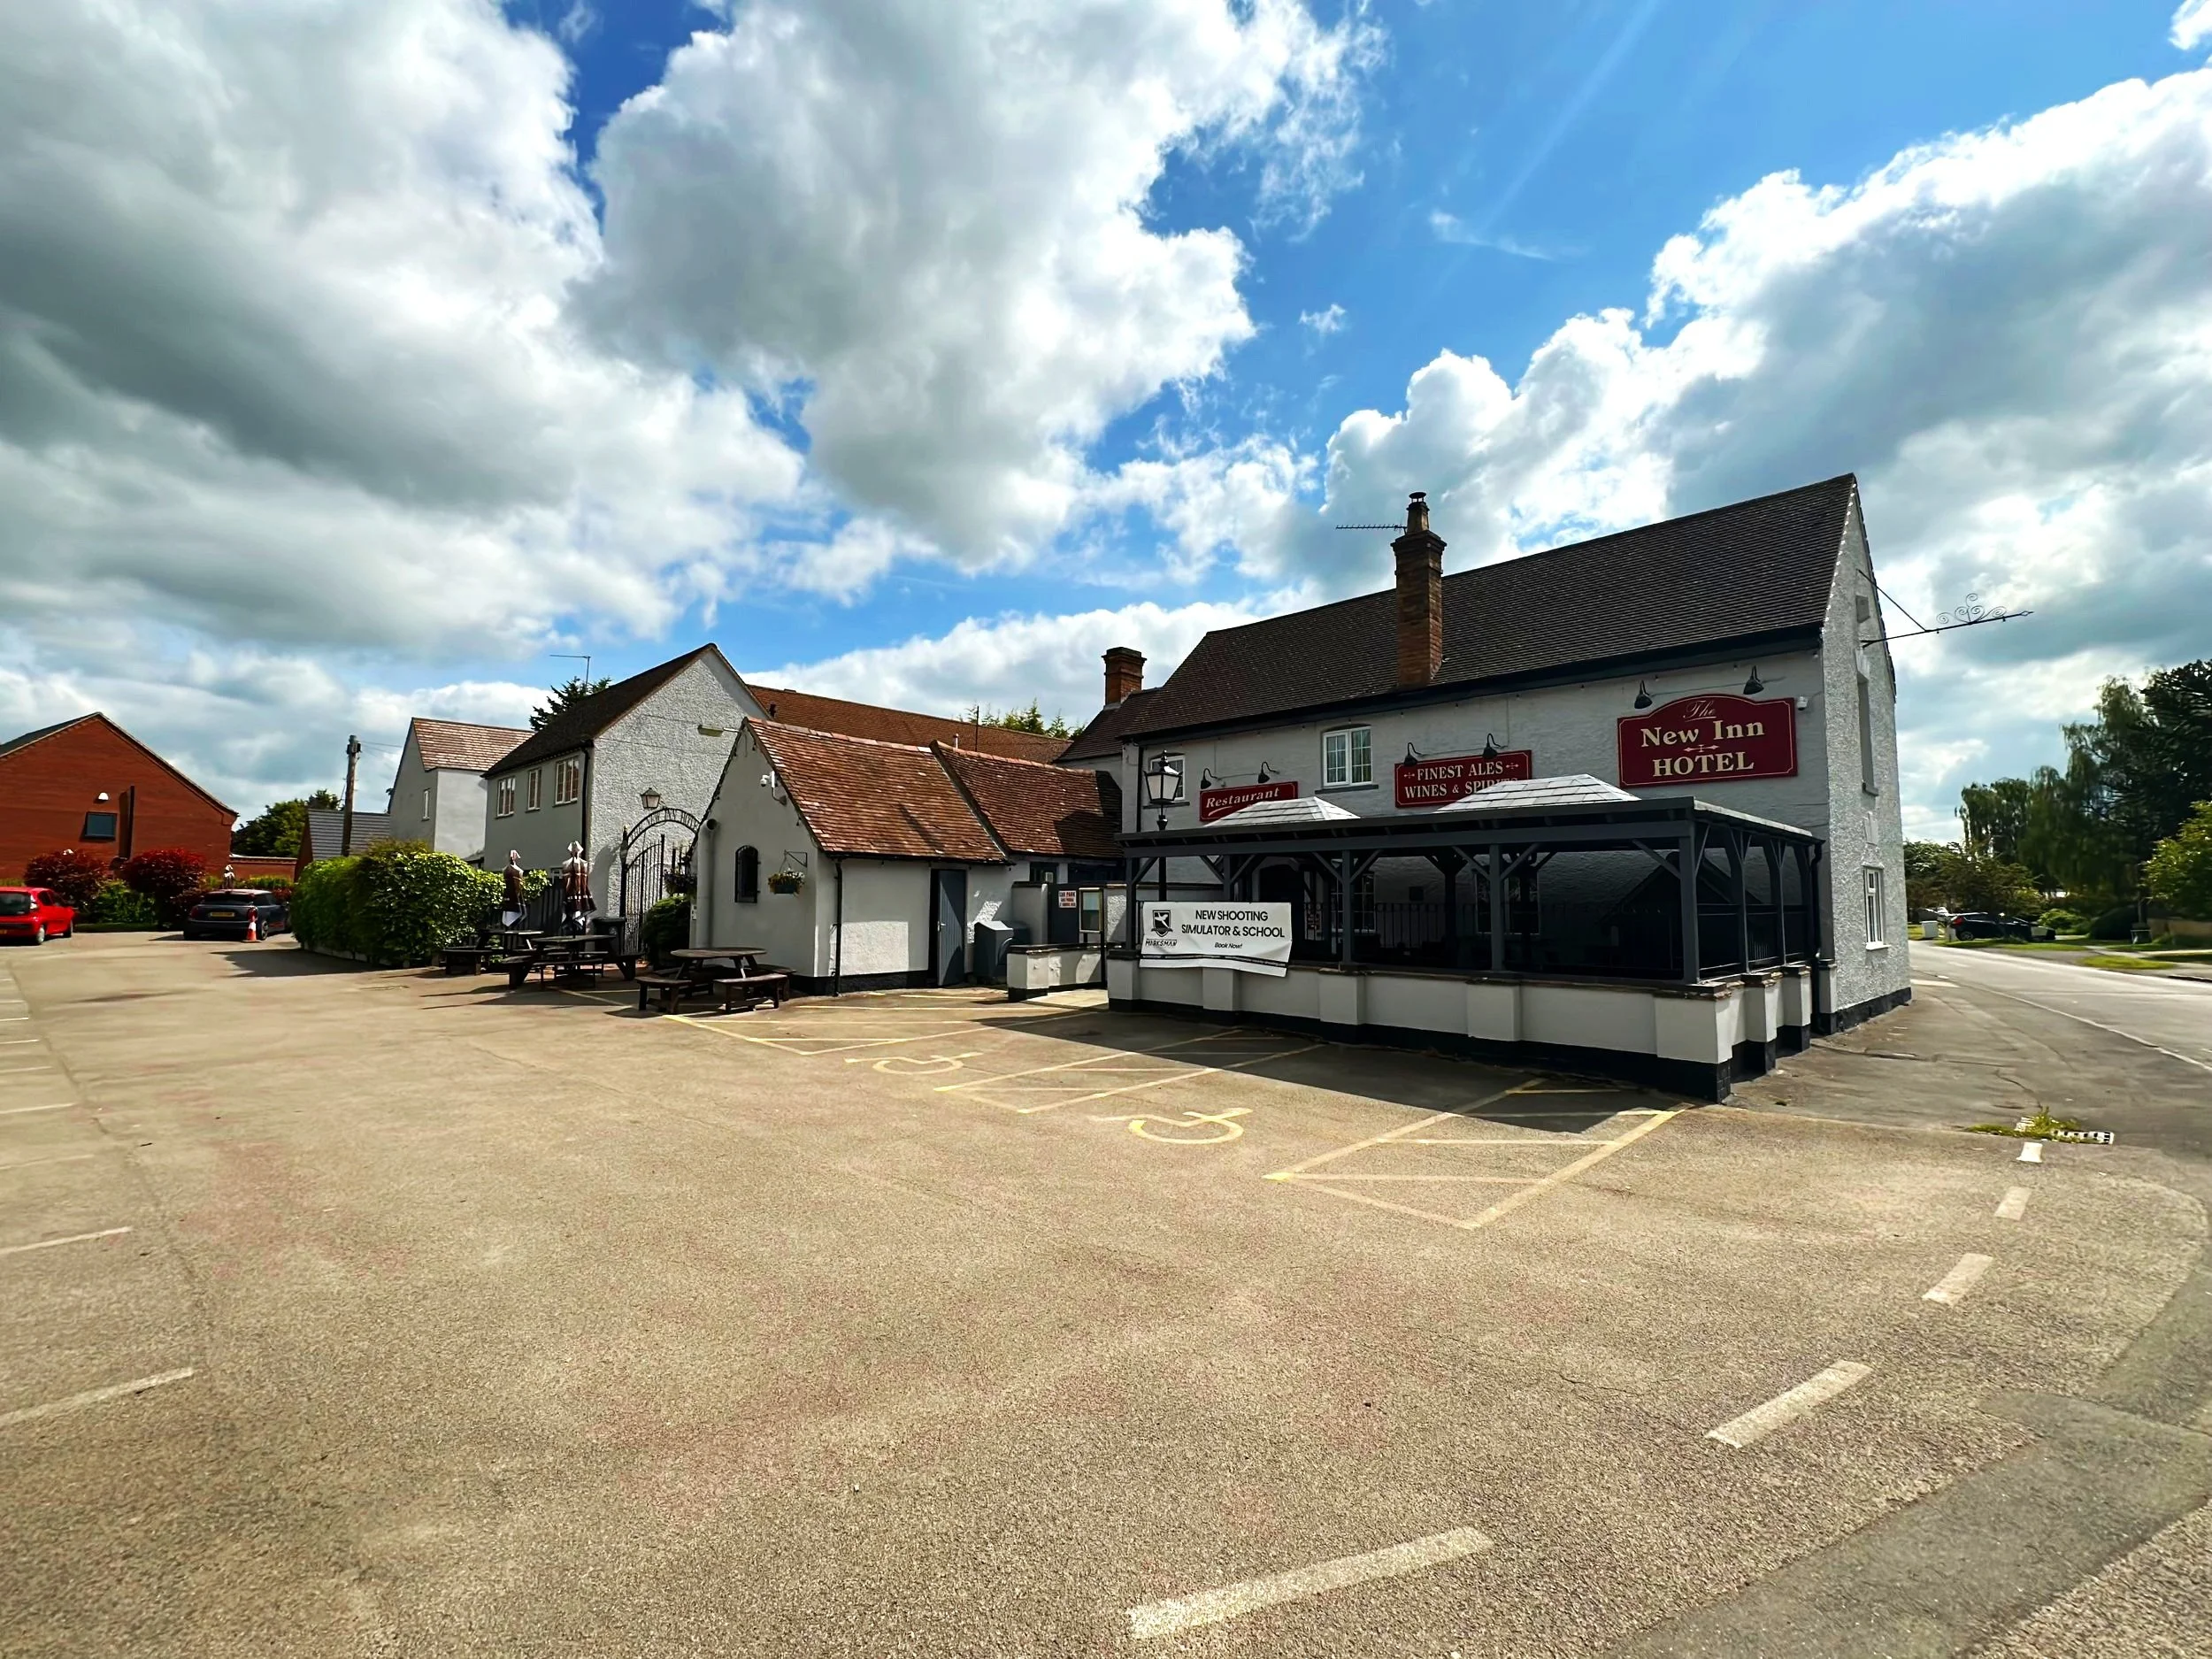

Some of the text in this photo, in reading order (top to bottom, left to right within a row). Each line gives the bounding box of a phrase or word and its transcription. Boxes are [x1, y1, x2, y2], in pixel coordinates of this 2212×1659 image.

[1683, 700, 1717, 720] The
[1640, 720, 1765, 747] New Inn
[1417, 761, 1503, 781] FINEST ALES
[1652, 752, 1755, 777] HOTEL
[1206, 787, 1280, 808] Restaurant
[1404, 778, 1518, 799] WINES & SPIR
[1195, 910, 1268, 922] NEW SHOOTING
[1181, 925, 1286, 938] SIMULATOR & SCHOOL
